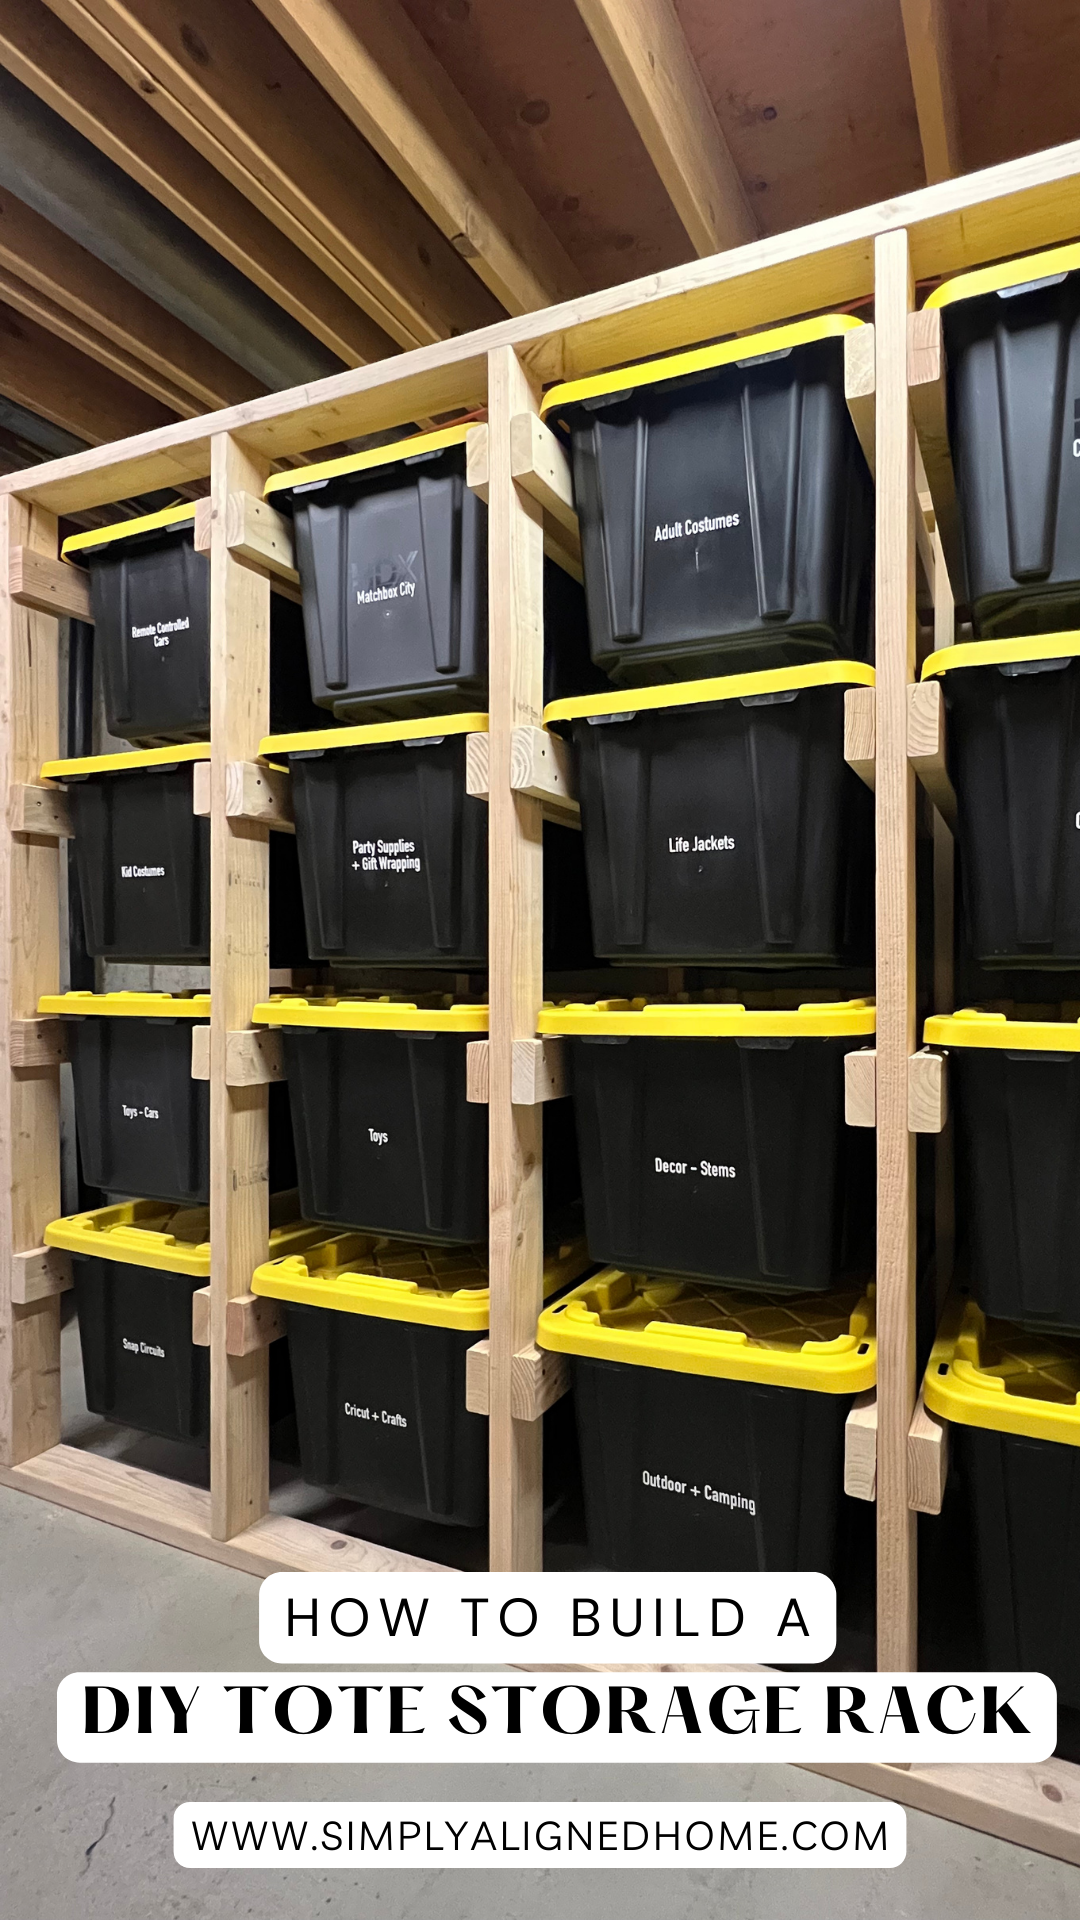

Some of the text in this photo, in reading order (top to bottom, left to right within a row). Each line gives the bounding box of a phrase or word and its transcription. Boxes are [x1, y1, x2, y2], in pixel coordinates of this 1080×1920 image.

[654, 513, 740, 542] Adult Costumes
[356, 581, 416, 605] Matchbox City
[131, 616, 190, 639] Remote Controlled
[153, 635, 170, 648] Cars
[352, 838, 416, 859] Party Supplies
[668, 834, 735, 853] Life Jackets
[120, 865, 166, 878] Kid Costumes
[361, 855, 379, 871] Gift
[378, 855, 421, 873] Wrapping
[121, 1104, 138, 1120] Toys
[143, 1106, 160, 1120] Cars
[367, 1127, 389, 1146] Toys
[654, 1157, 688, 1175] Decor
[699, 1160, 736, 1179] Stems
[122, 1337, 166, 1358] Snap Circuits
[344, 1402, 371, 1420] Cricut
[381, 1410, 408, 1428] Crafts
[642, 1470, 687, 1494] Outdoor
[704, 1484, 756, 1516] Camping
